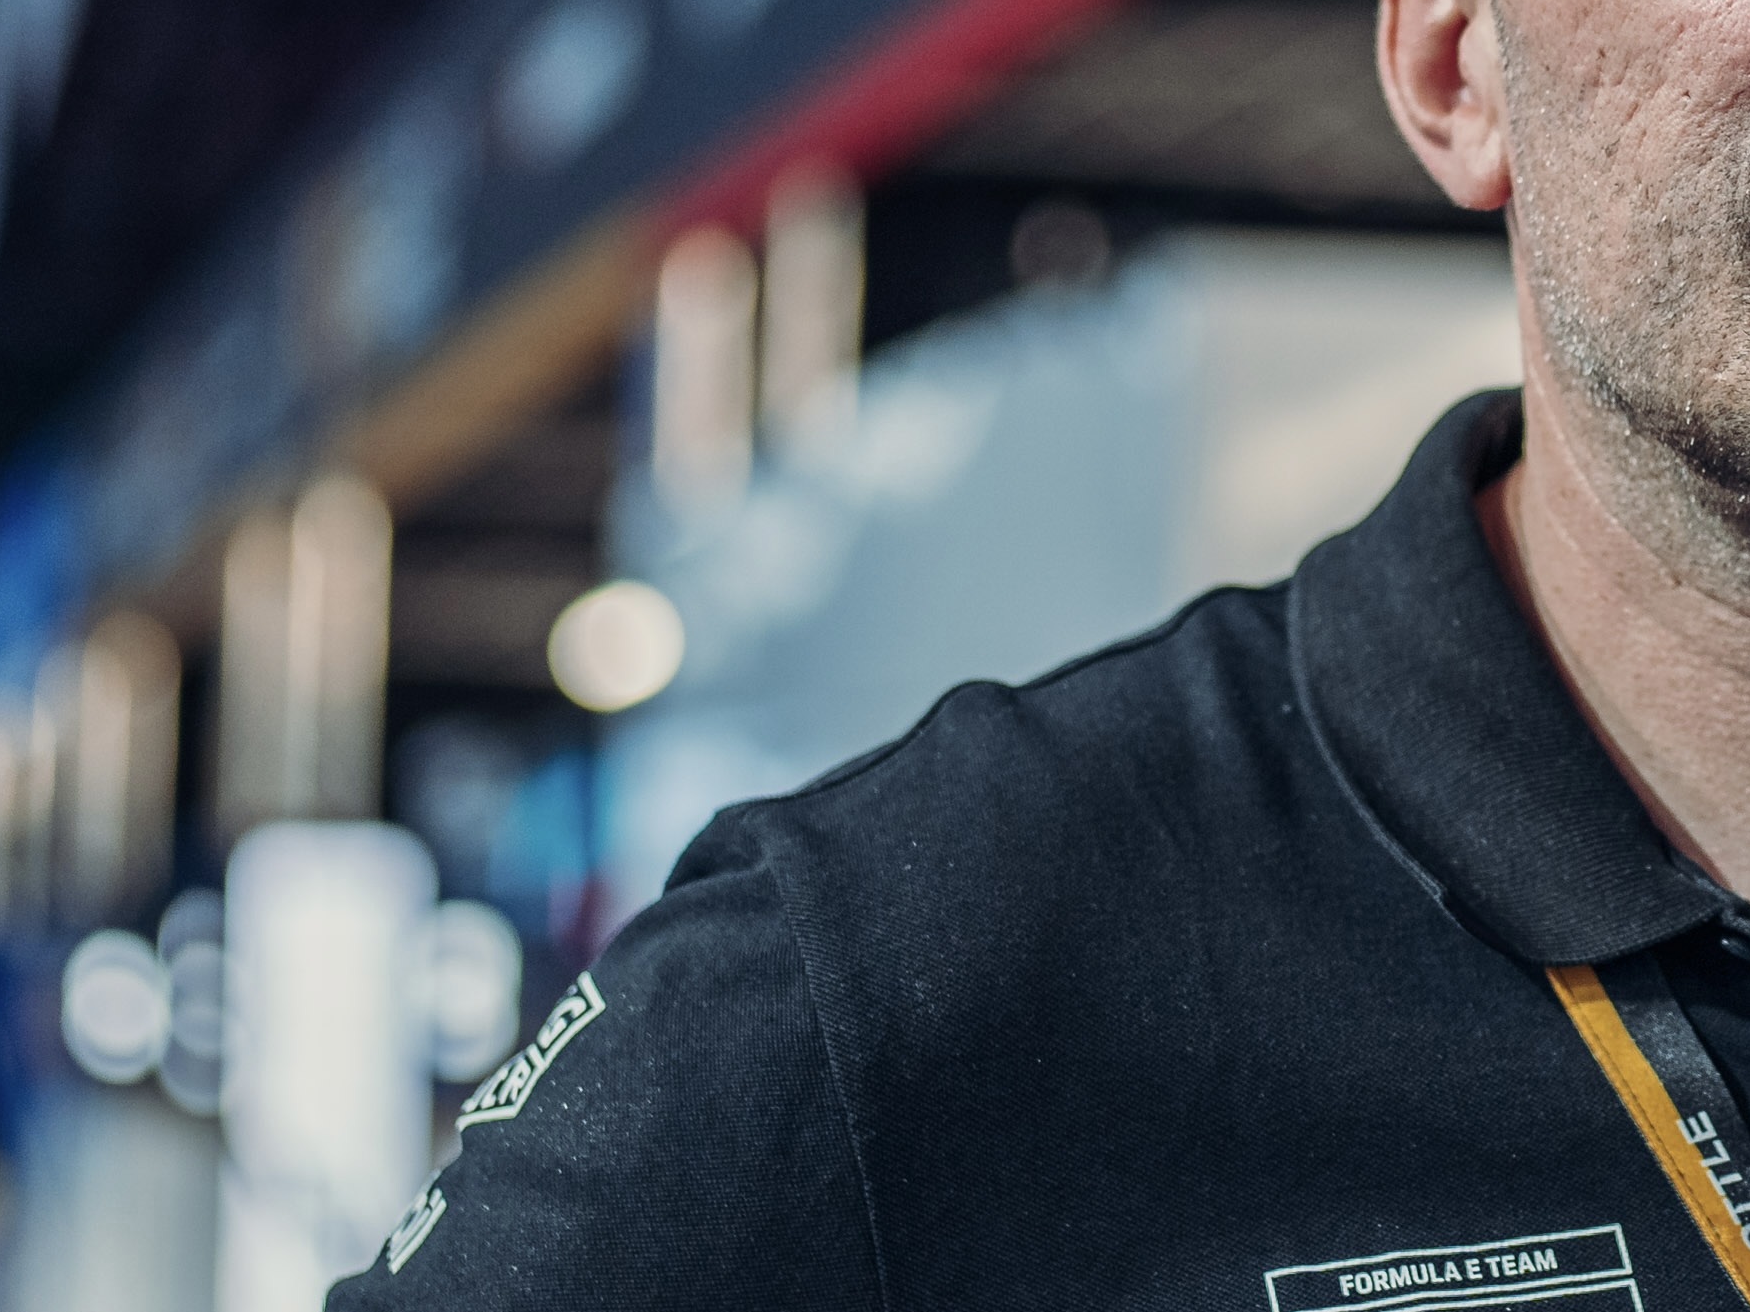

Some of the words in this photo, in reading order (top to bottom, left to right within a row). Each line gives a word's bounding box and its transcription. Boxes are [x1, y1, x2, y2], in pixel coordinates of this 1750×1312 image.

[1339, 1263, 1463, 1297] FORMULA
[1464, 1258, 1483, 1280] E
[1484, 1248, 1558, 1278] TEAM
